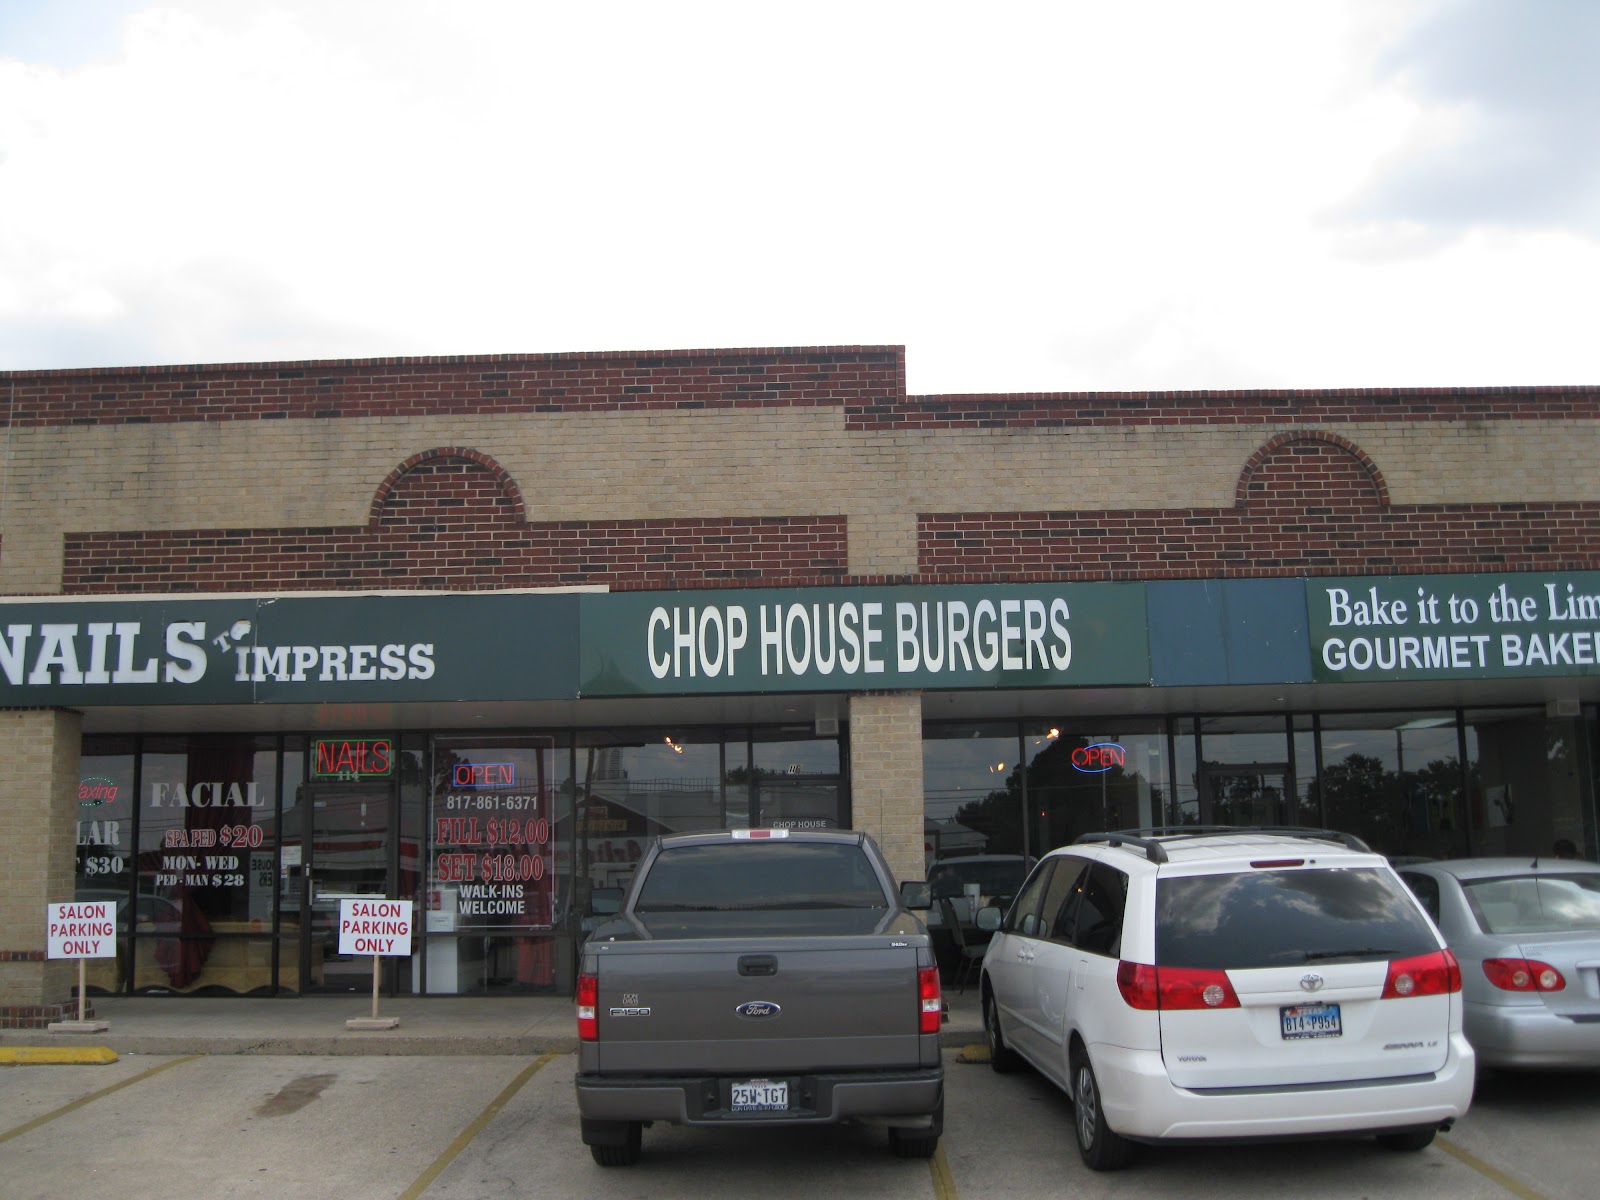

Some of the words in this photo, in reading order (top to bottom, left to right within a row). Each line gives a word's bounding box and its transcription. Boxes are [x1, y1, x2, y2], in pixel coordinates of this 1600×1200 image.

[1326, 587, 1408, 626] Bake
[1417, 587, 1441, 624] it
[1448, 594, 1479, 623] to
[1488, 584, 1537, 622] the
[1543, 583, 1600, 620] Lim
[647, 605, 748, 678] CHOP
[760, 602, 885, 675] HOUSE
[896, 598, 1072, 673] BURGERS
[0, 621, 207, 685] NAILS
[235, 643, 436, 682] IMPRESS
[1322, 635, 1490, 671] GOURMET
[317, 741, 389, 773] NAILS
[1071, 747, 1125, 766] OPEN
[456, 766, 513, 784] OPEN
[78, 783, 119, 803] axing
[150, 782, 265, 808] FACIAL
[447, 795, 538, 810] 817-861-6371
[436, 817, 482, 845] FILL
[487, 817, 549, 848] $12.00
[773, 821, 796, 829] CHOP
[798, 820, 827, 829] HOUSE
[76, 820, 120, 846] LAR
[165, 828, 189, 848] SPA
[191, 828, 217, 848] PED
[219, 824, 264, 848] $20
[85, 856, 124, 877] $30
[204, 855, 239, 870] WED
[437, 853, 476, 882] SET
[481, 853, 544, 885] $18.00
[156, 874, 178, 886] PED
[185, 874, 209, 886] MAN
[459, 884, 524, 898] WALK-INS
[59, 905, 105, 919] SALON
[352, 903, 401, 917] SALON
[459, 900, 525, 915] WELCOME
[51, 922, 113, 937] PARKING
[342, 920, 408, 935] PARKING
[63, 940, 100, 954] ONLY
[355, 938, 394, 953] ONLY
[746, 1004, 770, 1015] Ford
[1297, 1007, 1323, 1015] TEXAS
